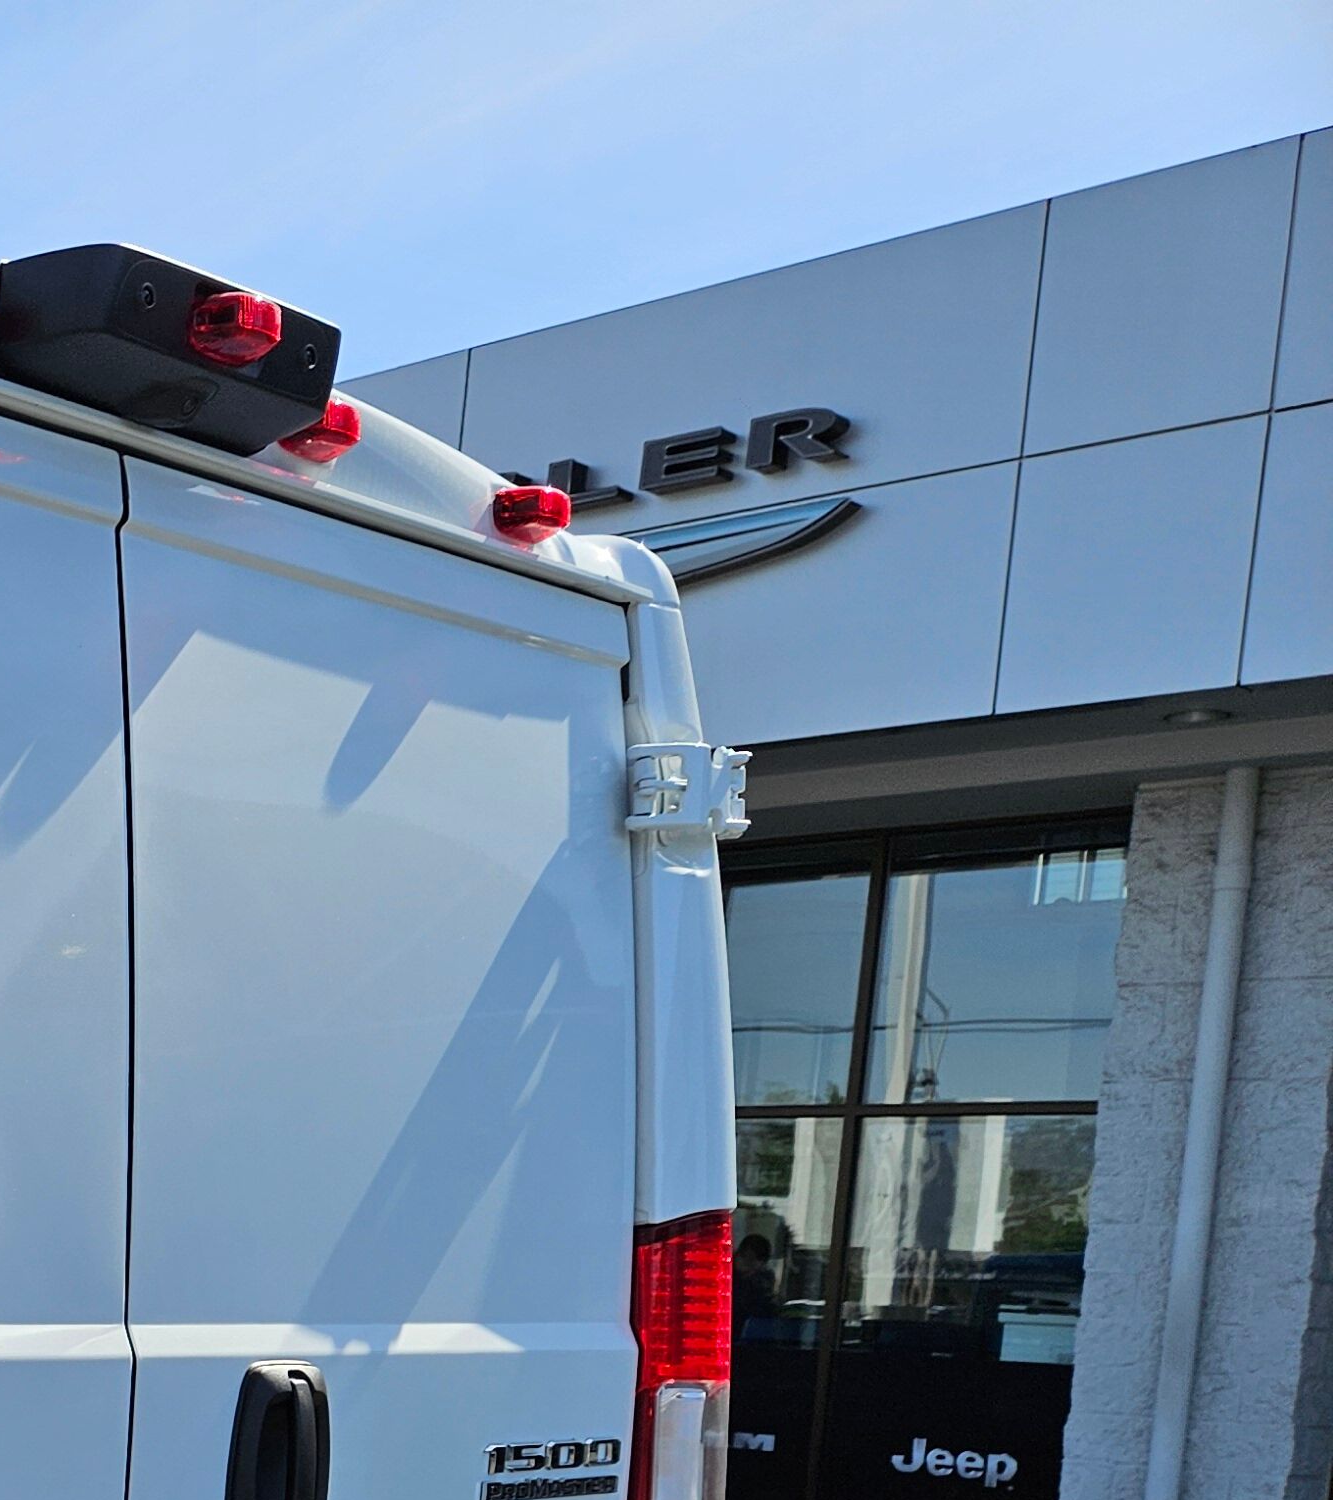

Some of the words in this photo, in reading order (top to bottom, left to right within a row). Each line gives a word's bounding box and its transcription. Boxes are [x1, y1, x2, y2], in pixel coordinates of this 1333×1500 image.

[499, 407, 851, 512] LER
[484, 1438, 621, 1475] 1500
[891, 1437, 1018, 1488] Jeep
